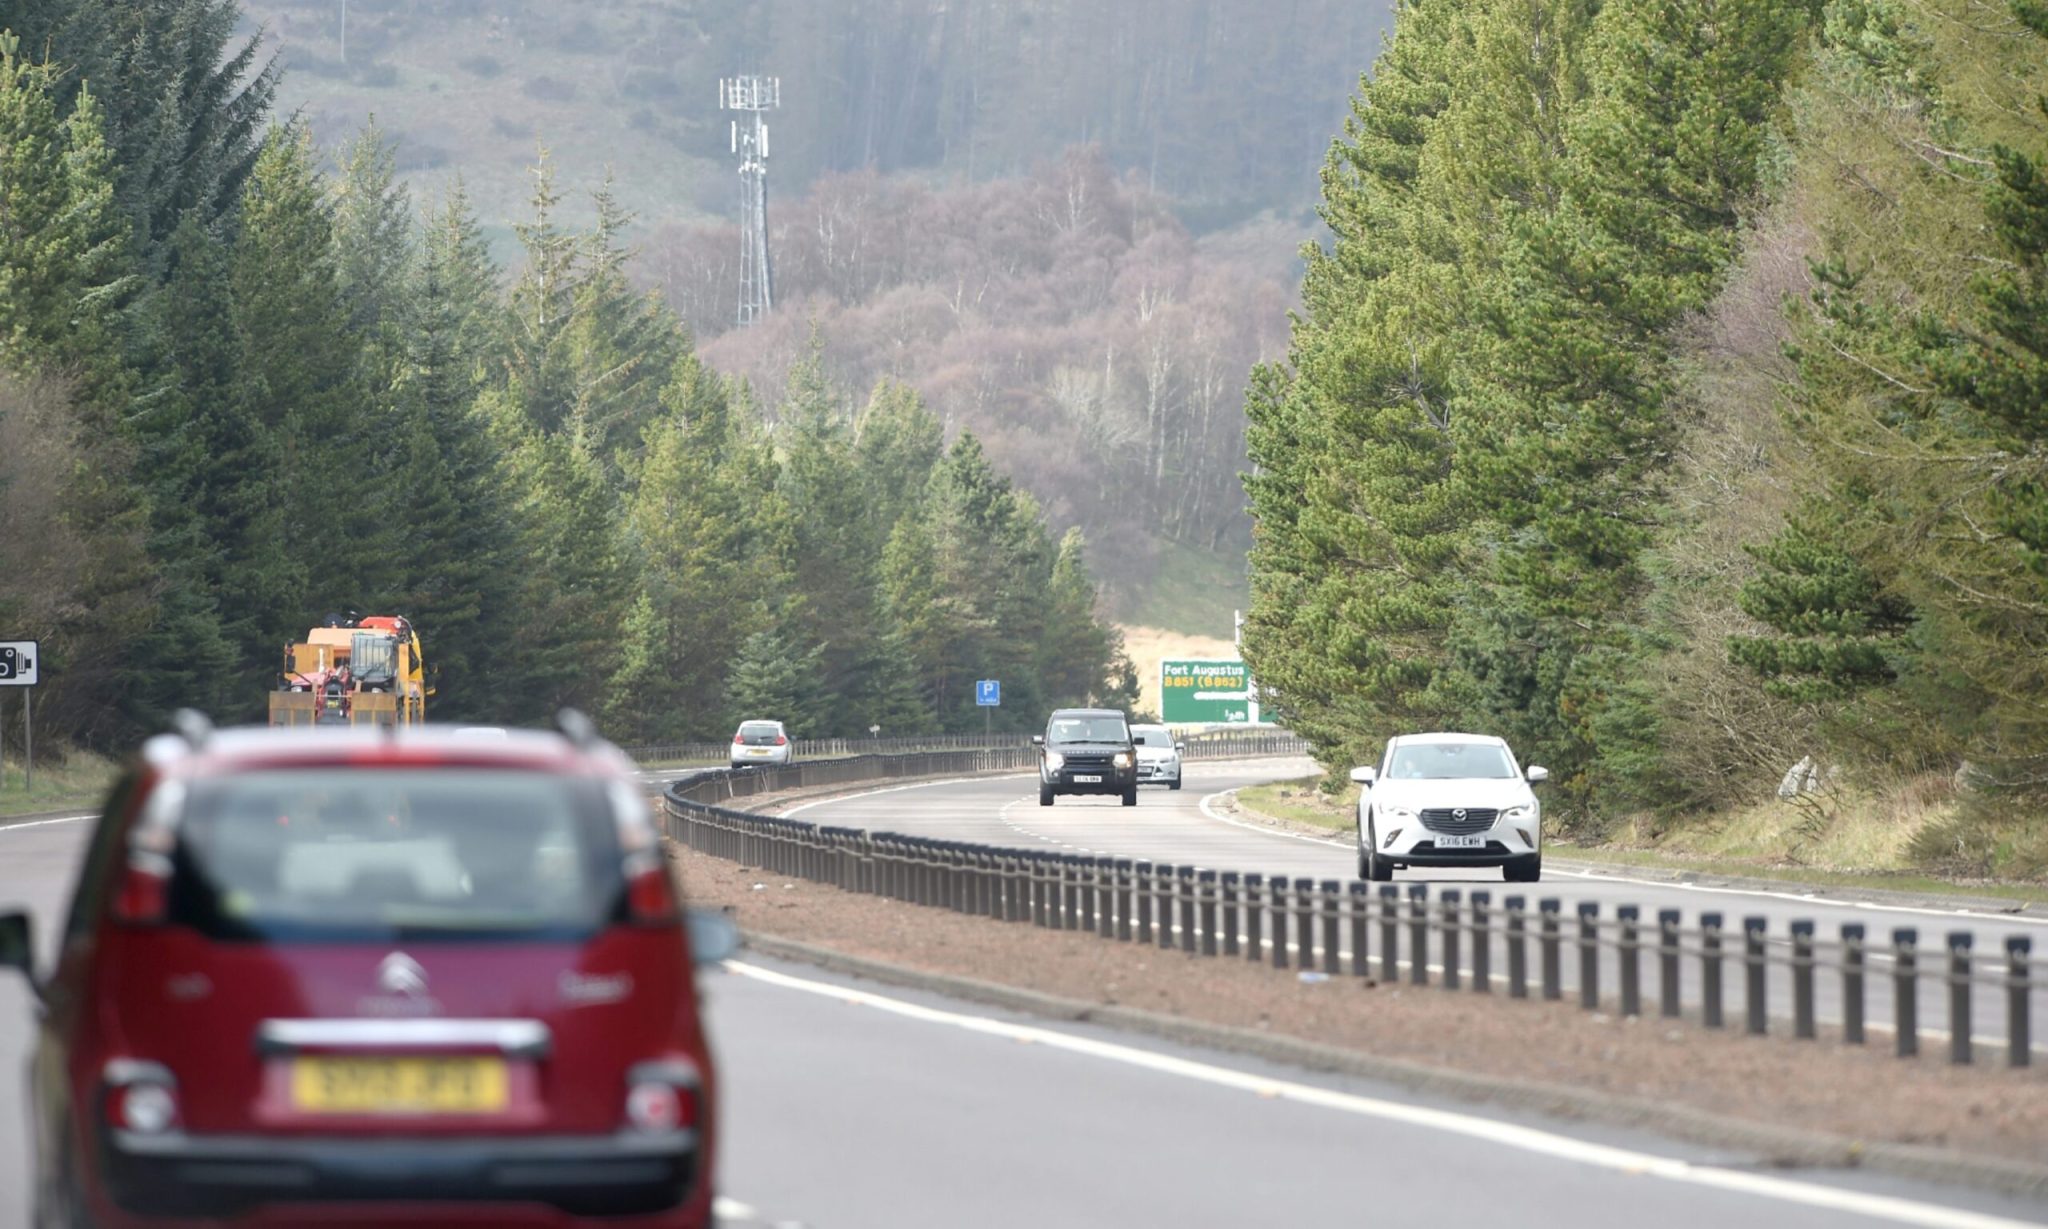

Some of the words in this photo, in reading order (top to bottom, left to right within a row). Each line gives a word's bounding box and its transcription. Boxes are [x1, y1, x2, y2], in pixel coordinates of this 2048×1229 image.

[1164, 664, 1189, 675] Fort
[1192, 664, 1245, 677] Augustus
[984, 683, 994, 696] P
[1440, 837, 1460, 846] SX16
[1462, 837, 1480, 846] EWH
